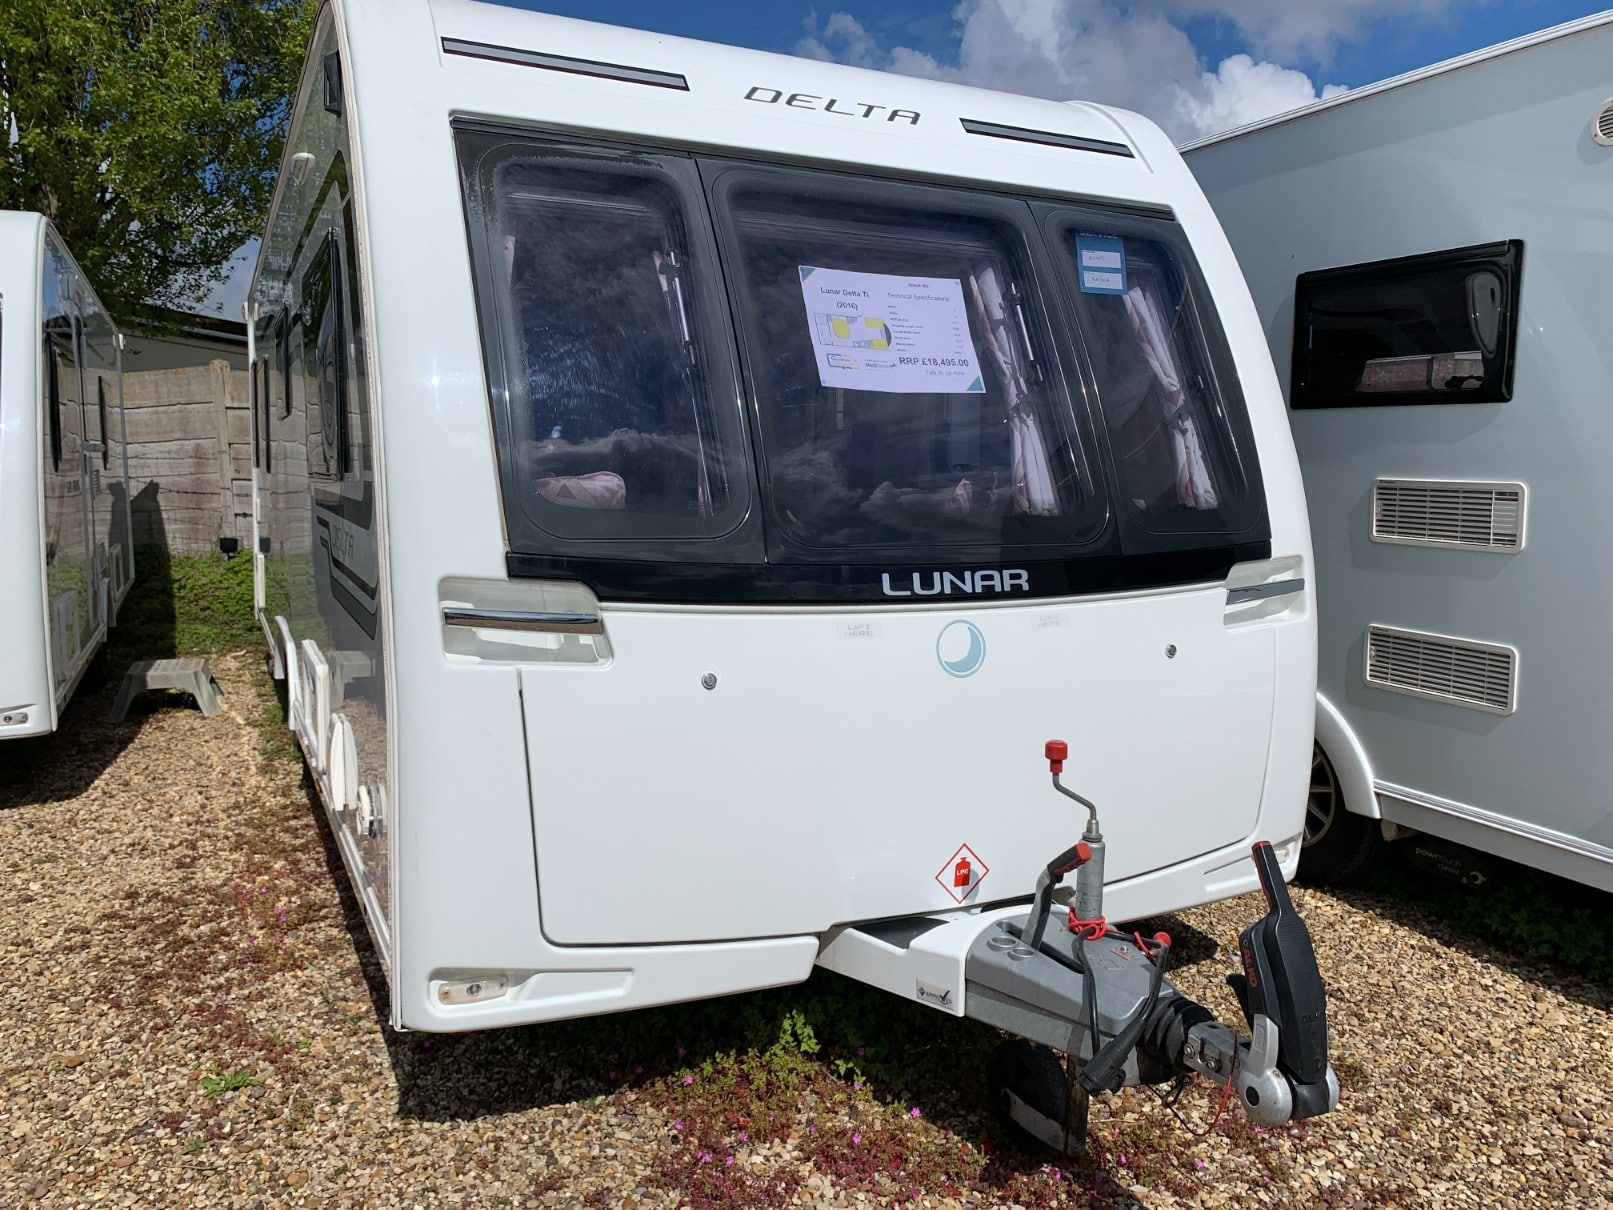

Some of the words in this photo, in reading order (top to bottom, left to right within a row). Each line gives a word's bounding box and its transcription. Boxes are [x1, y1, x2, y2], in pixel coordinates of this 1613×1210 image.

[743, 86, 921, 126] DELTA
[820, 286, 841, 295] Lunar
[842, 289, 861, 297] Delta
[887, 292, 913, 300] Technical
[913, 293, 950, 302] Specifications
[836, 301, 858, 311] (2016)
[899, 357, 919, 366] RRP
[921, 358, 969, 368] £18,495.00
[881, 569, 1030, 596] LUNAR
[956, 868, 969, 876] LPG
